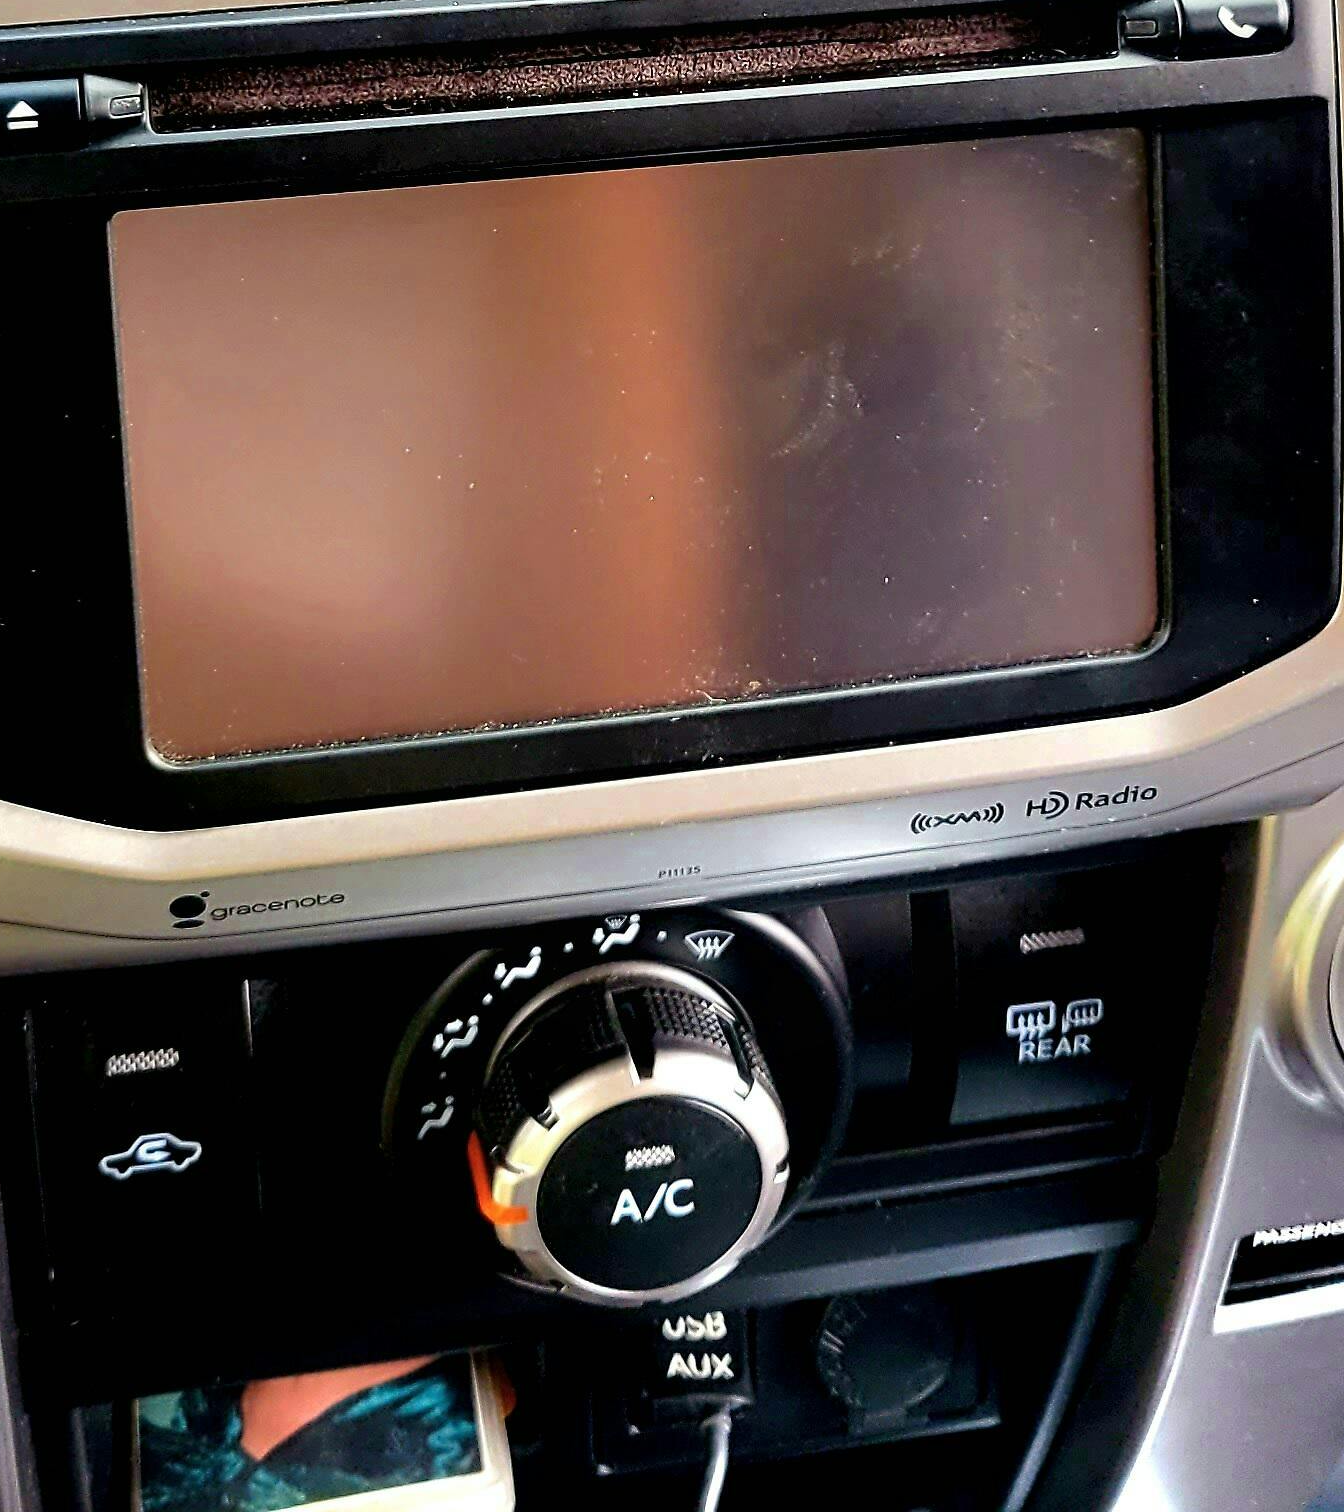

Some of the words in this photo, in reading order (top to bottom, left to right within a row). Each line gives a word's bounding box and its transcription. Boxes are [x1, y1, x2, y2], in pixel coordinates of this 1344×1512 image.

[1025, 790, 1070, 820] HD
[1075, 785, 1158, 811] Radio
[210, 893, 346, 922] gracenote
[1018, 1034, 1092, 1064] REAR
[609, 1177, 696, 1227] A/C
[661, 1309, 729, 1341] USB
[666, 1352, 735, 1381] AUX
